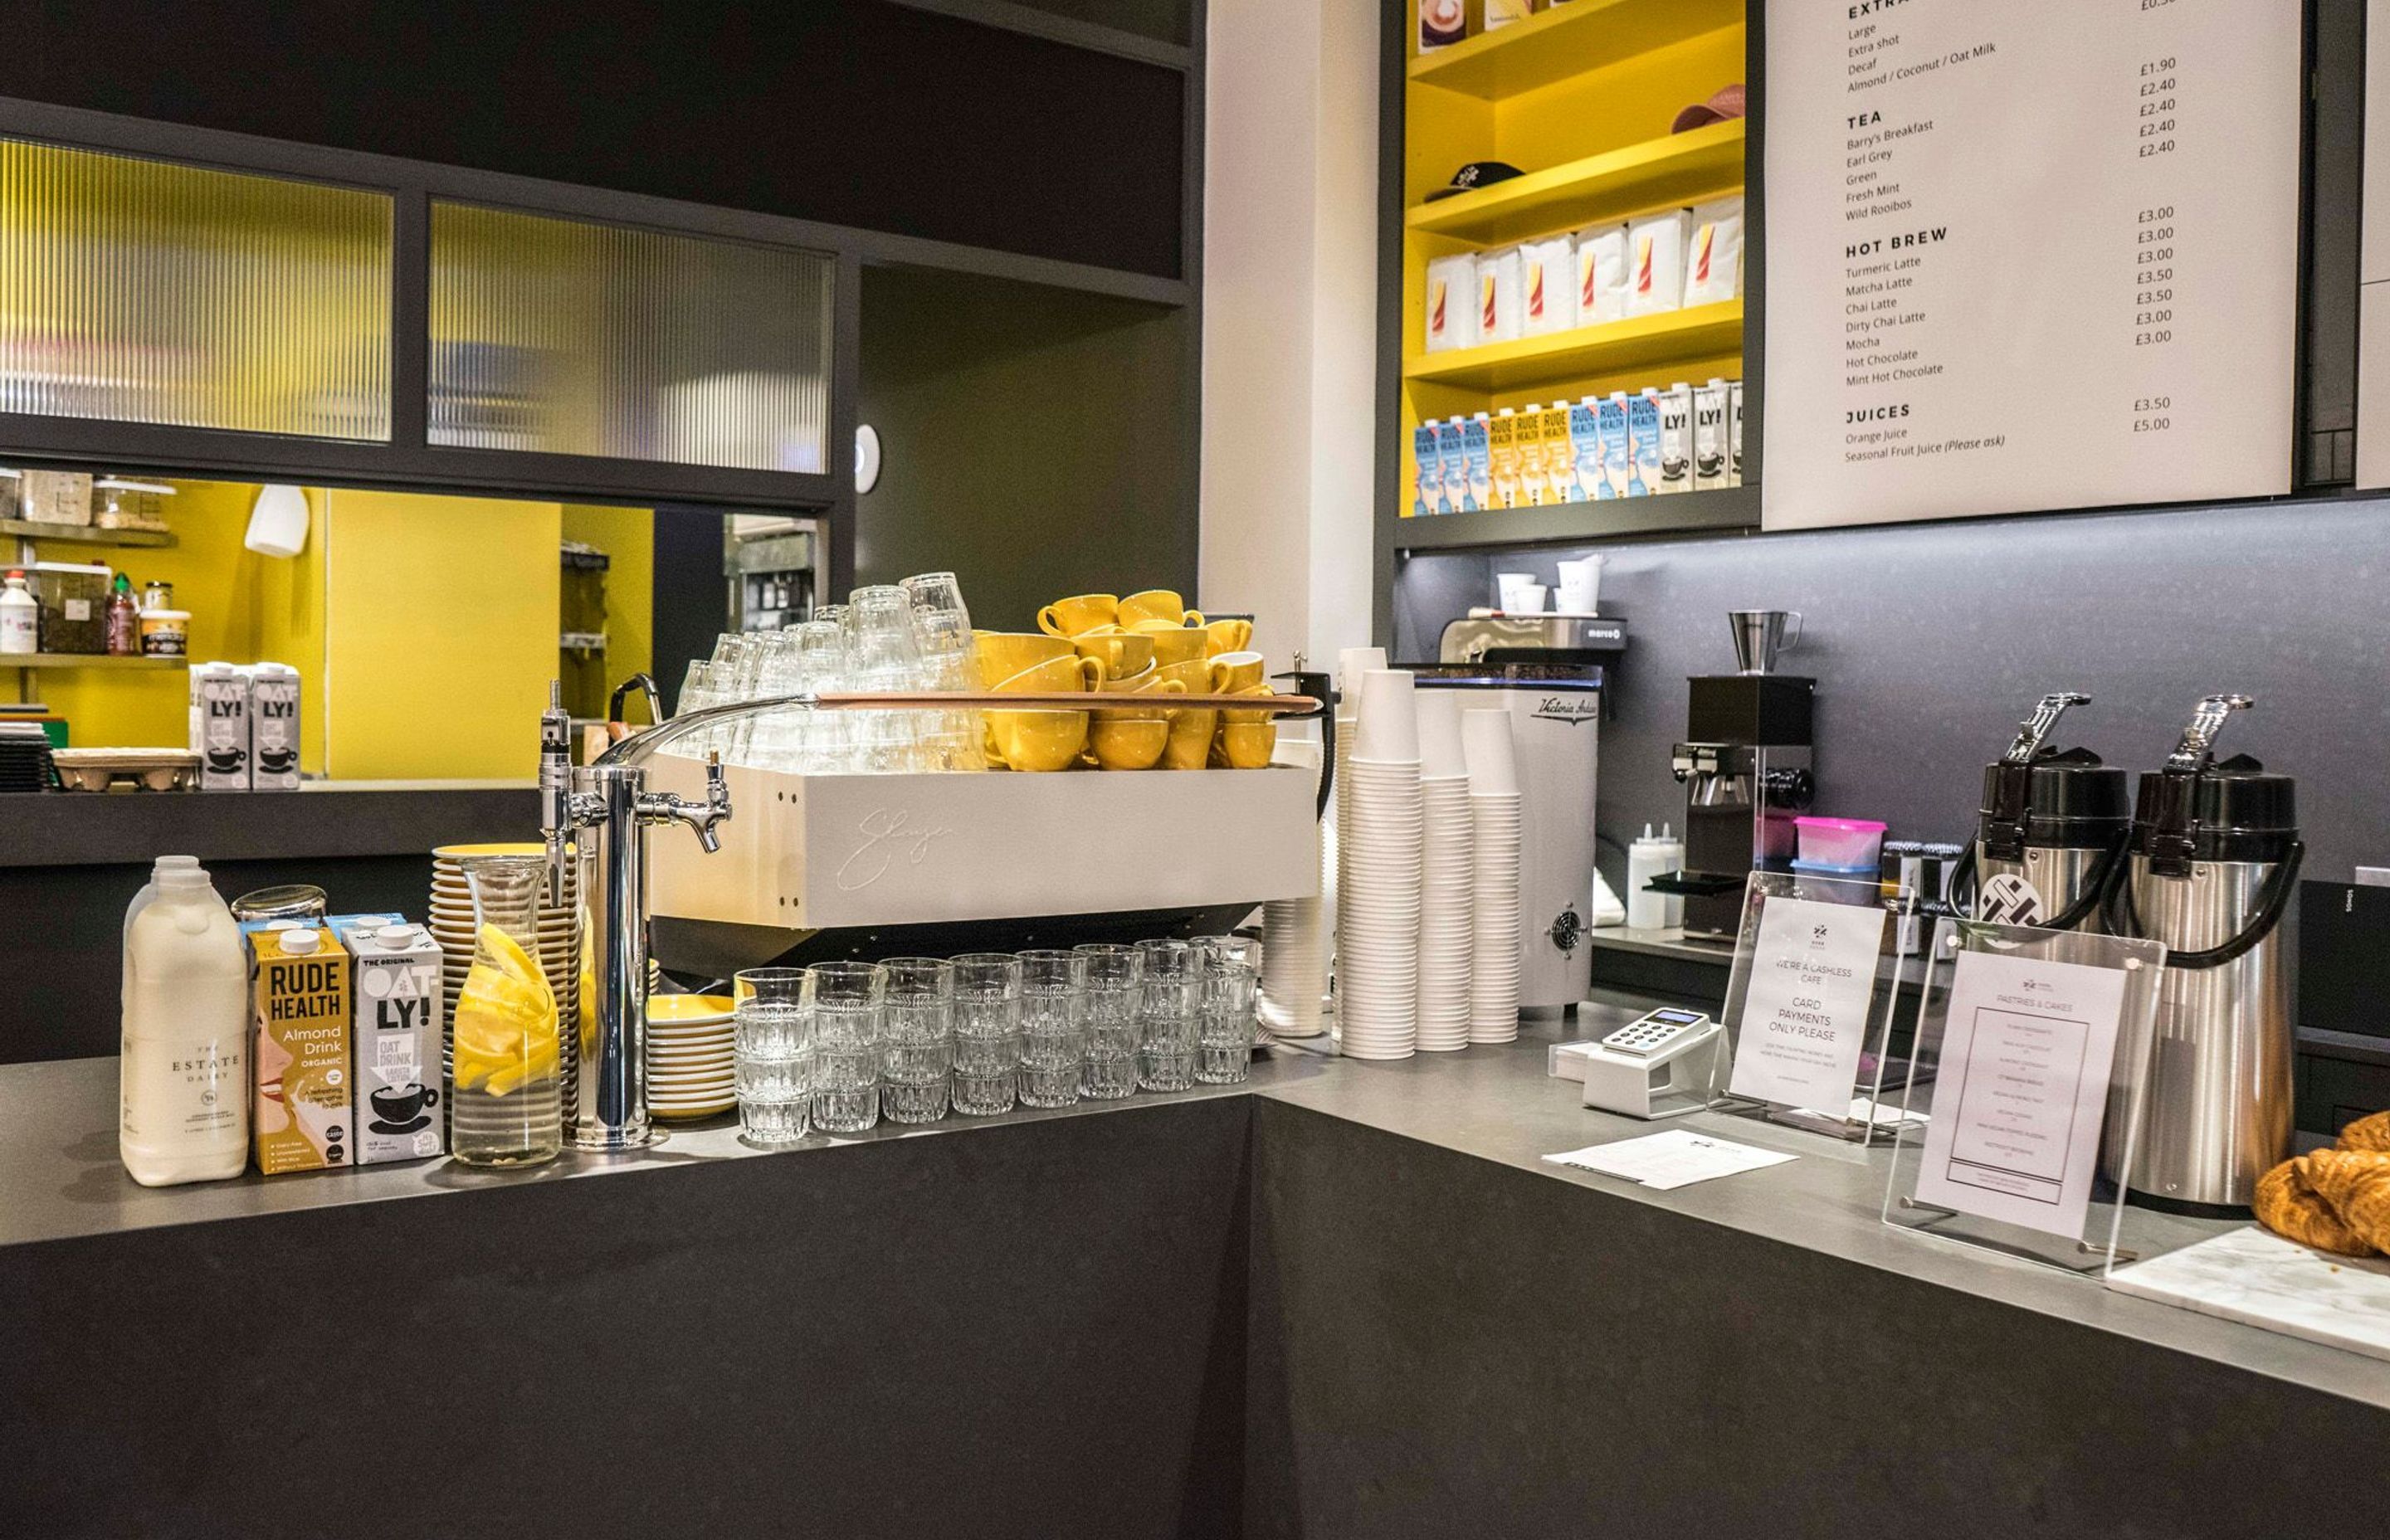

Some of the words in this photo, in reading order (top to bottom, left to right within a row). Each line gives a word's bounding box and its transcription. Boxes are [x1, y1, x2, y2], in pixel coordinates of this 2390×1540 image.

[2141, 0, 2176, 11] £0.
[1849, 24, 1876, 41] Large
[1849, 42, 1874, 58] Extra
[1877, 34, 1899, 50] shot
[1848, 57, 1876, 76] Decaf
[1848, 72, 1886, 94] Almond
[1896, 58, 1939, 80] Coconut
[1950, 50, 1969, 65] Oat
[1973, 41, 1996, 58] Milk
[2141, 56, 2176, 76] £1.90
[2140, 77, 2175, 97] £2.40
[2140, 98, 2175, 117] £2.40
[1847, 110, 1881, 129] TEA
[1847, 134, 1880, 151] Barry's
[1884, 119, 1933, 142] Breakfast
[2140, 119, 2175, 138] £2.40
[2139, 139, 2174, 158] £2.40
[1846, 154, 1866, 168] Earl
[1869, 150, 1892, 163] Grey
[1846, 171, 1876, 186] Green
[1846, 188, 1873, 203] Fresh
[1877, 183, 1899, 197] Mint
[1846, 207, 1867, 222] Wild
[1871, 199, 1912, 216] Rooibos
[2139, 206, 2173, 223] £3.00
[1846, 239, 1881, 259] HOT
[1891, 226, 1947, 251] BREW
[2139, 227, 2173, 245] £3.00
[2138, 247, 2173, 265] £3.00
[1846, 263, 1890, 279] Turmeric
[1895, 257, 1920, 270] Latte
[2138, 267, 2173, 285] £3.50
[1846, 282, 1883, 297] Matcha
[1886, 276, 1912, 290] Latte
[2137, 288, 2172, 305] £3.50
[1846, 303, 1867, 315] Chai
[1871, 298, 1897, 310] Latte
[1846, 321, 1870, 334] Dirty
[1873, 316, 1895, 329] Chai
[1900, 312, 1925, 325] Latte
[2136, 309, 2172, 326] £3.00
[1846, 338, 1880, 351] Mocha
[2136, 329, 2171, 346] £3.00
[1846, 358, 1864, 368] Hot
[1867, 349, 1918, 366] Chocolate
[1846, 374, 1869, 387] Mint
[1872, 372, 1890, 383] Hot
[1893, 364, 1943, 381] Chocolate
[2134, 397, 2170, 412] £3.50
[1517, 415, 1539, 430] RUDE
[1544, 411, 1567, 426] RUDE
[1666, 414, 1685, 430] LY!
[1700, 409, 1721, 426] LY!
[1846, 403, 1910, 425] JUICES
[2134, 417, 2170, 432] £5.00
[1846, 432, 1881, 445] Orange
[1884, 429, 1907, 441] Juice
[1846, 446, 1888, 462] Seasonal
[1891, 446, 1914, 457] Fruit
[1917, 443, 1942, 457] Juice
[1944, 439, 1981, 453] (Please
[1983, 434, 2005, 448] ask)
[211, 701, 241, 718] LY!
[263, 701, 293, 718] LY!
[1539, 698, 1573, 714] Victoria
[381, 958, 415, 966] ORIGINAL
[271, 962, 339, 996] RUDE
[1801, 974, 1822, 985] CAFE
[1810, 964, 1852, 978] CASHLESS
[271, 994, 340, 1021] HEALTH
[1792, 997, 1822, 1010] CARD
[377, 997, 430, 1030] LY!
[1778, 1009, 1832, 1026] PAYMENTS
[283, 1025, 341, 1042] Almond
[1769, 1021, 1796, 1034] ONLY
[1798, 1026, 1836, 1041] PLEASE
[305, 1040, 343, 1055] Drink
[380, 1040, 400, 1053] OAT
[173, 1055, 239, 1072] ESTATE
[301, 1057, 342, 1068] ORGANIC
[380, 1052, 412, 1066] DRINK
